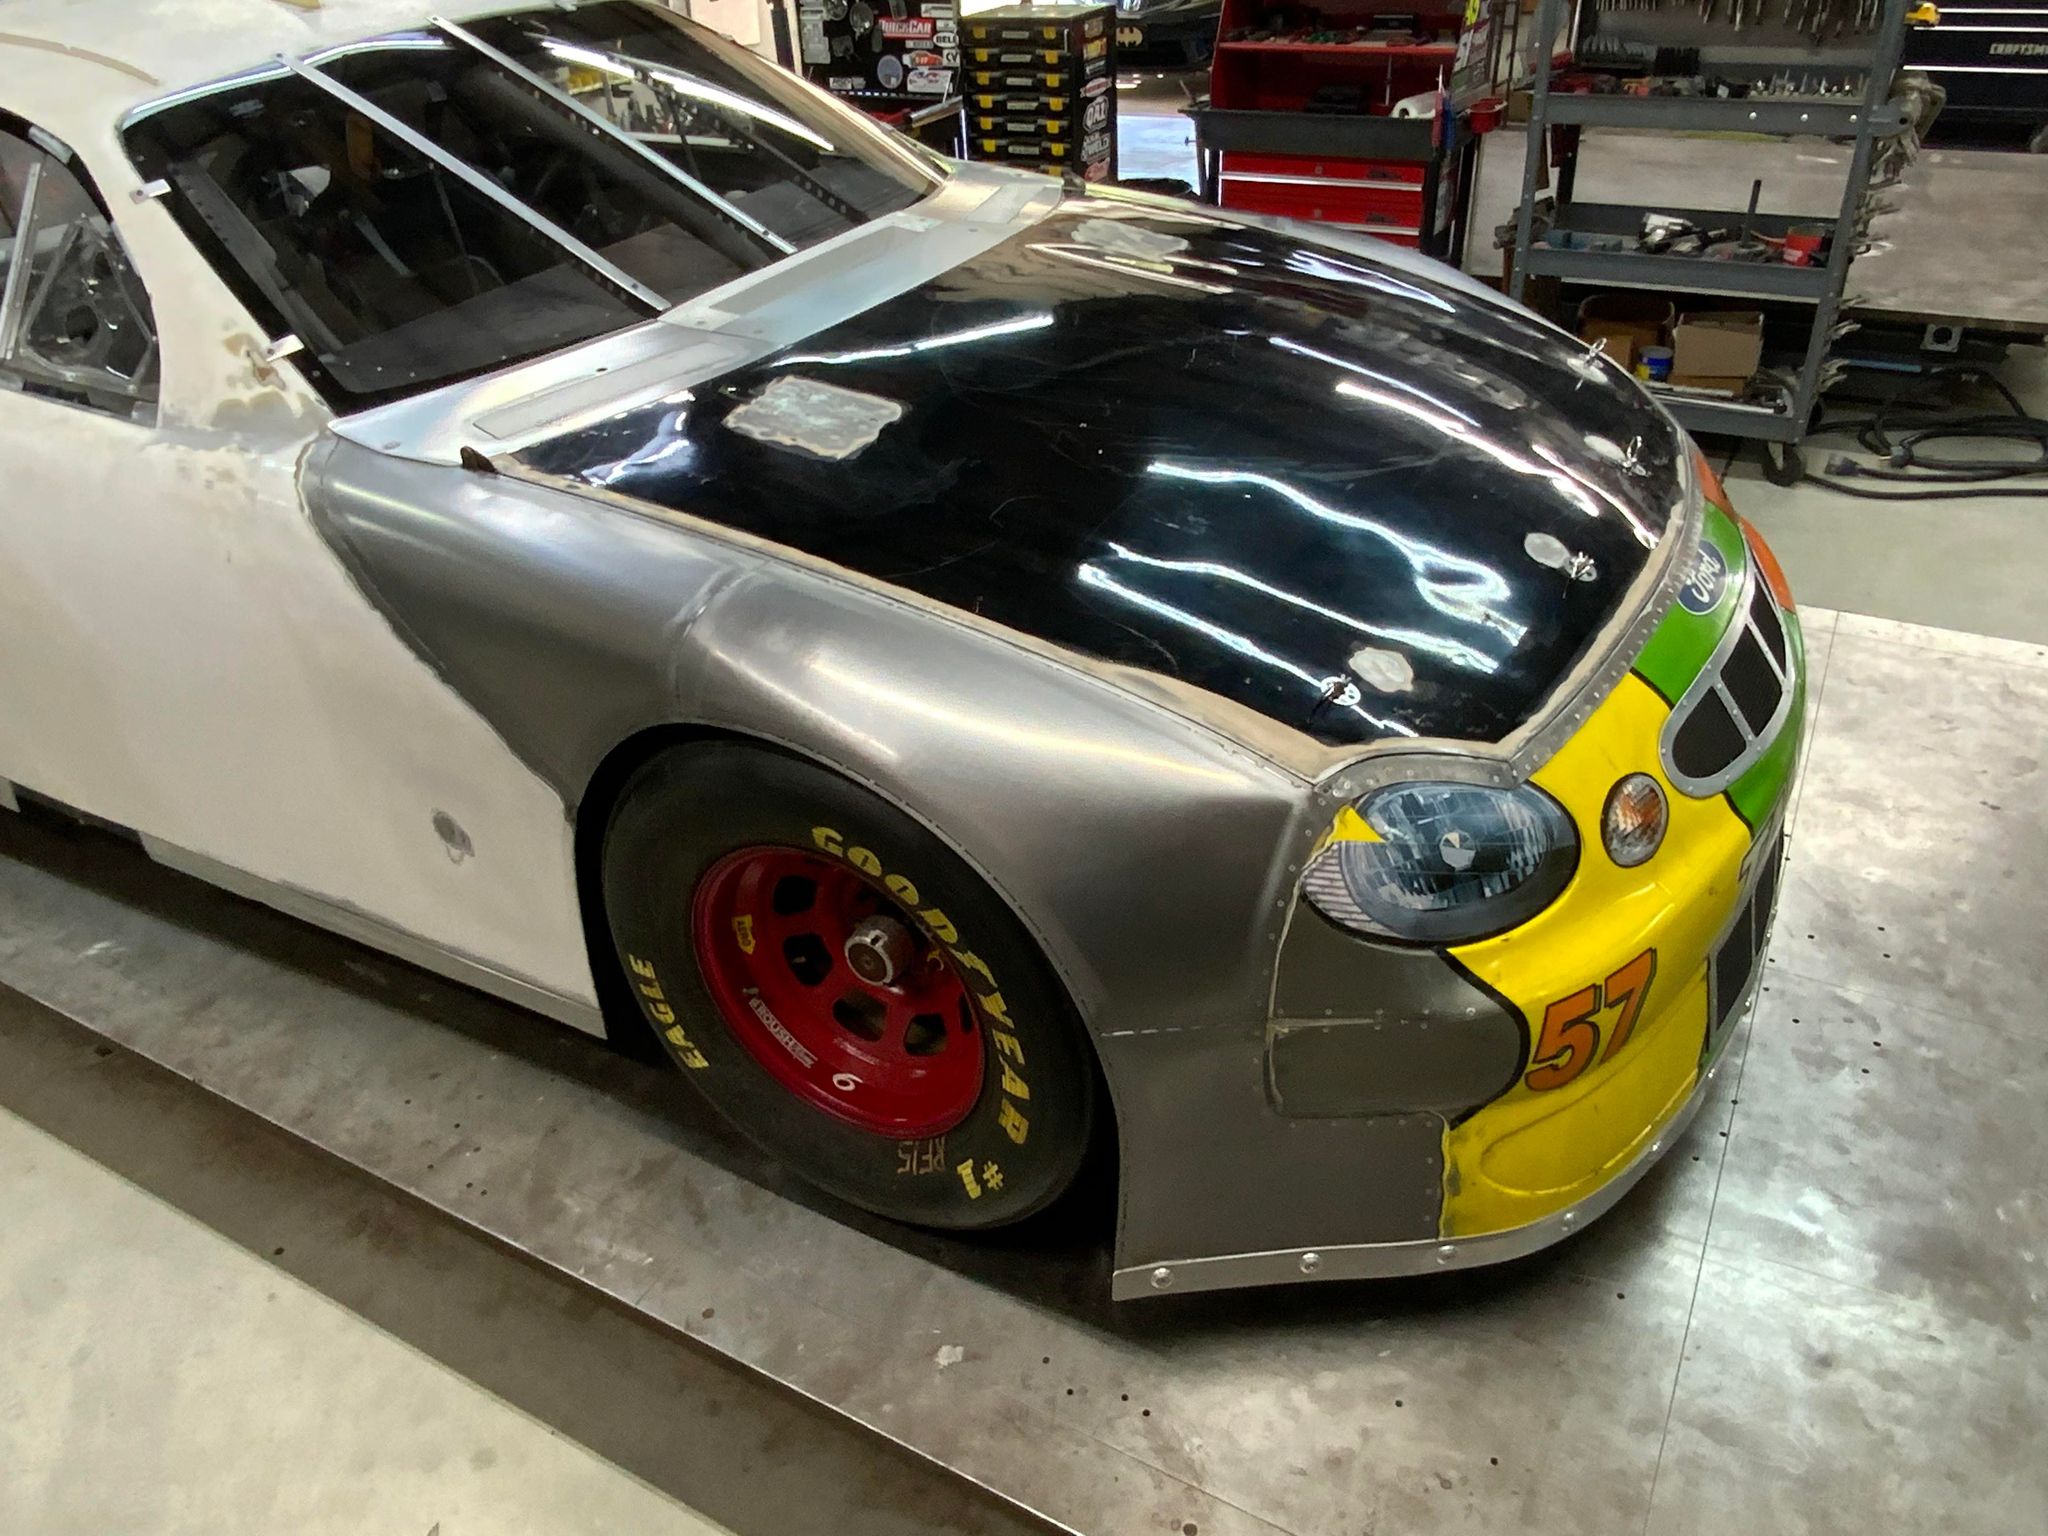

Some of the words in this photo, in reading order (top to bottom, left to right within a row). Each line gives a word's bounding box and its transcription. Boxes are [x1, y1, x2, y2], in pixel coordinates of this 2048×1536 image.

[1989, 43, 2048, 56] CRAFTSM
[1686, 548, 1720, 603] Ford
[629, 954, 709, 1068] EAGLE
[812, 827, 1030, 1144] GOODYEAR
[1524, 947, 1657, 1091] 57
